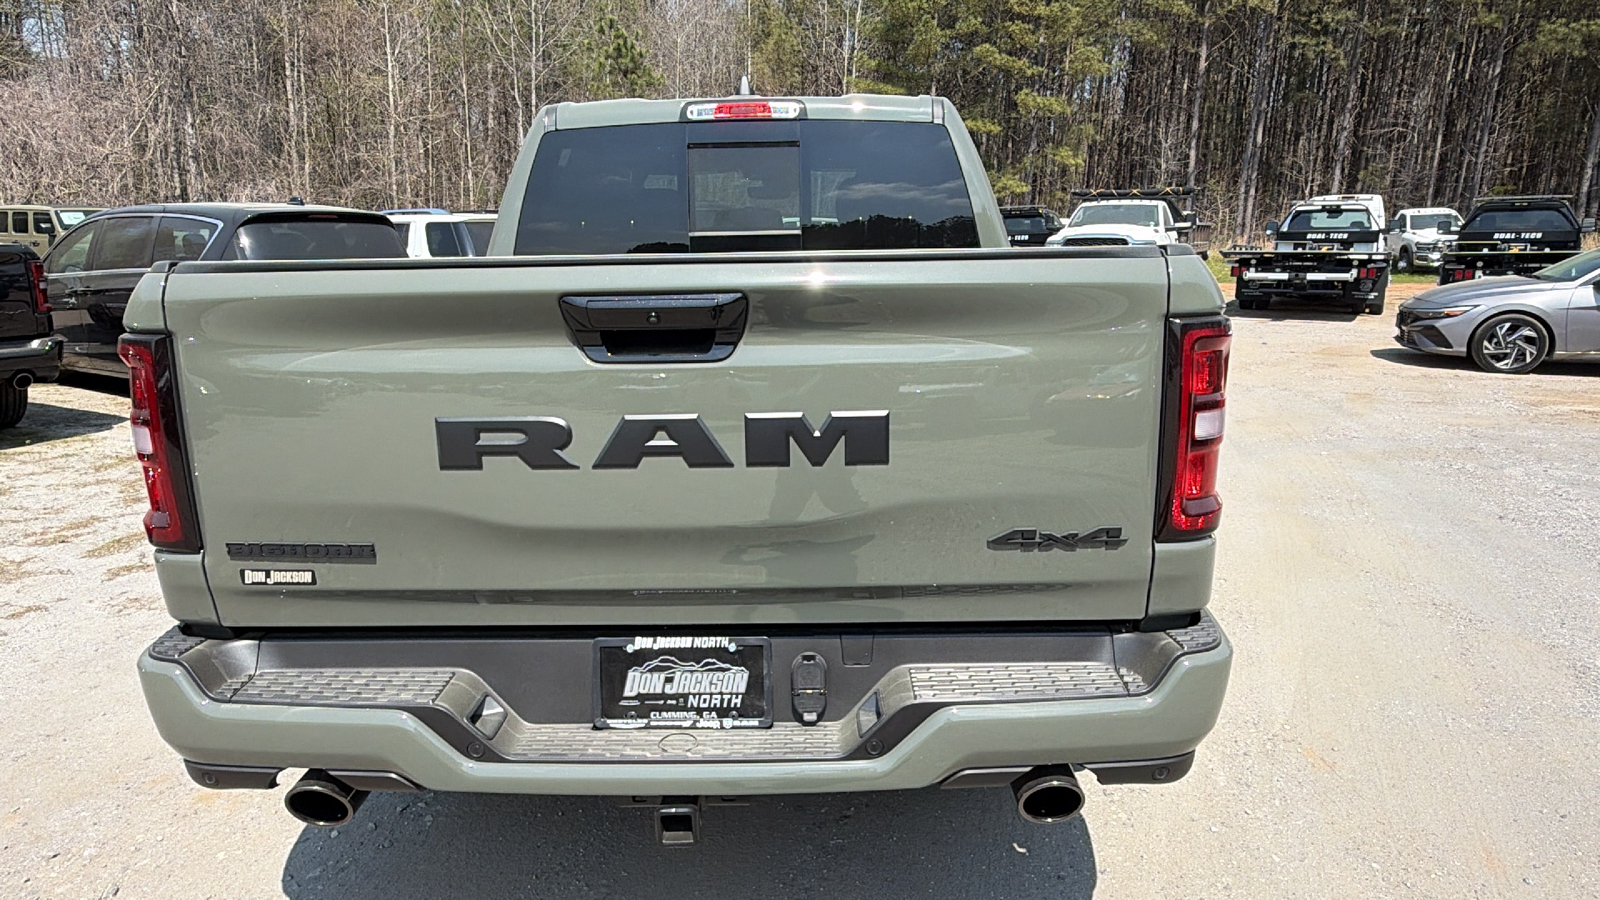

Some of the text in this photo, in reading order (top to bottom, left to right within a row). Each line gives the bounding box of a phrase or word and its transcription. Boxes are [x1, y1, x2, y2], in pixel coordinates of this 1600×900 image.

[435, 410, 889, 471] RAM
[245, 570, 312, 584] DON JACKSON
[634, 636, 729, 650] DON JACKSON NORTH
[623, 671, 749, 697] DON JACKSON
[687, 694, 743, 708] NORTH
[650, 711, 717, 719] CUMMING, GA
